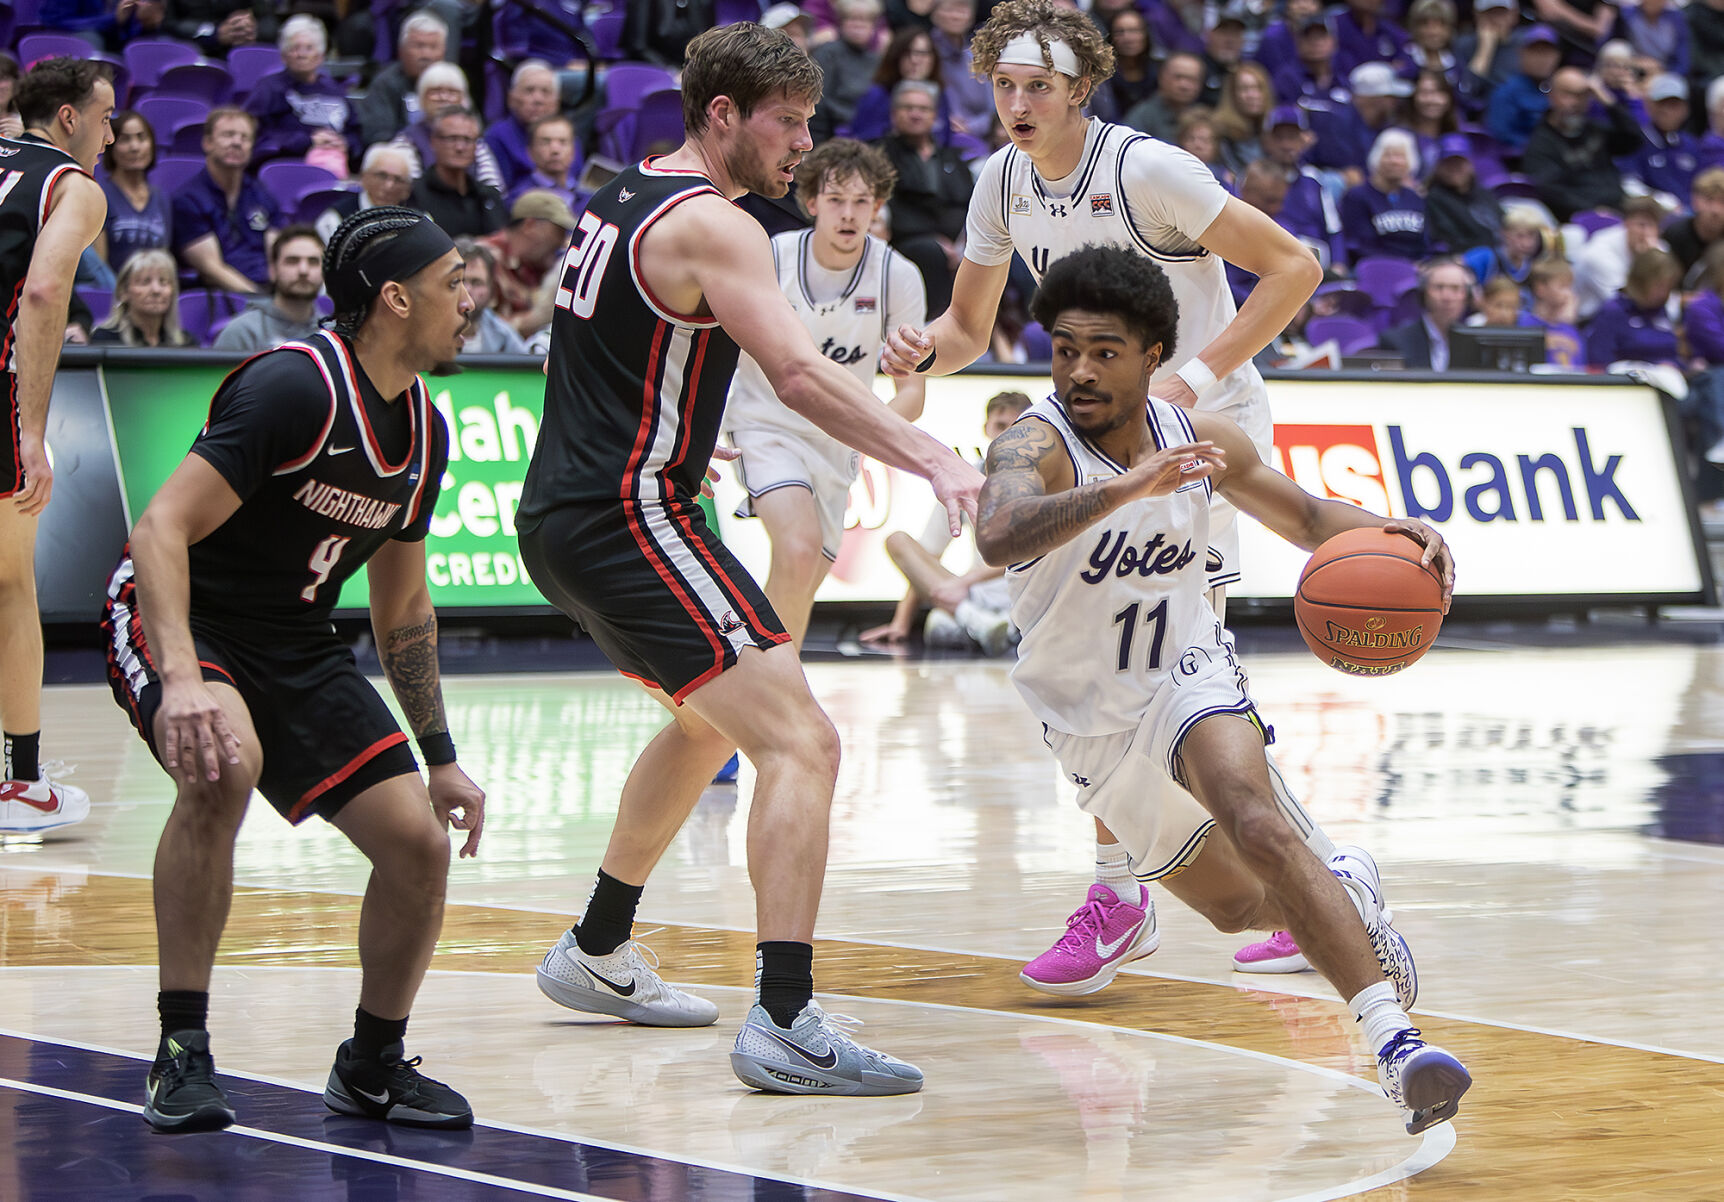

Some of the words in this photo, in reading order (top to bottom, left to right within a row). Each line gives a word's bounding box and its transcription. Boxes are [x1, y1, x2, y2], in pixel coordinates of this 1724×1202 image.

[554, 209, 620, 320] 20
[820, 337, 867, 365] tes
[1386, 425, 1641, 523] bank
[300, 533, 352, 603] 4
[426, 551, 531, 587] CREDI
[1080, 529, 1197, 585] Yotes
[1111, 595, 1170, 674] 11
[1324, 619, 1423, 648] SPALDING
[1179, 652, 1200, 677] G
